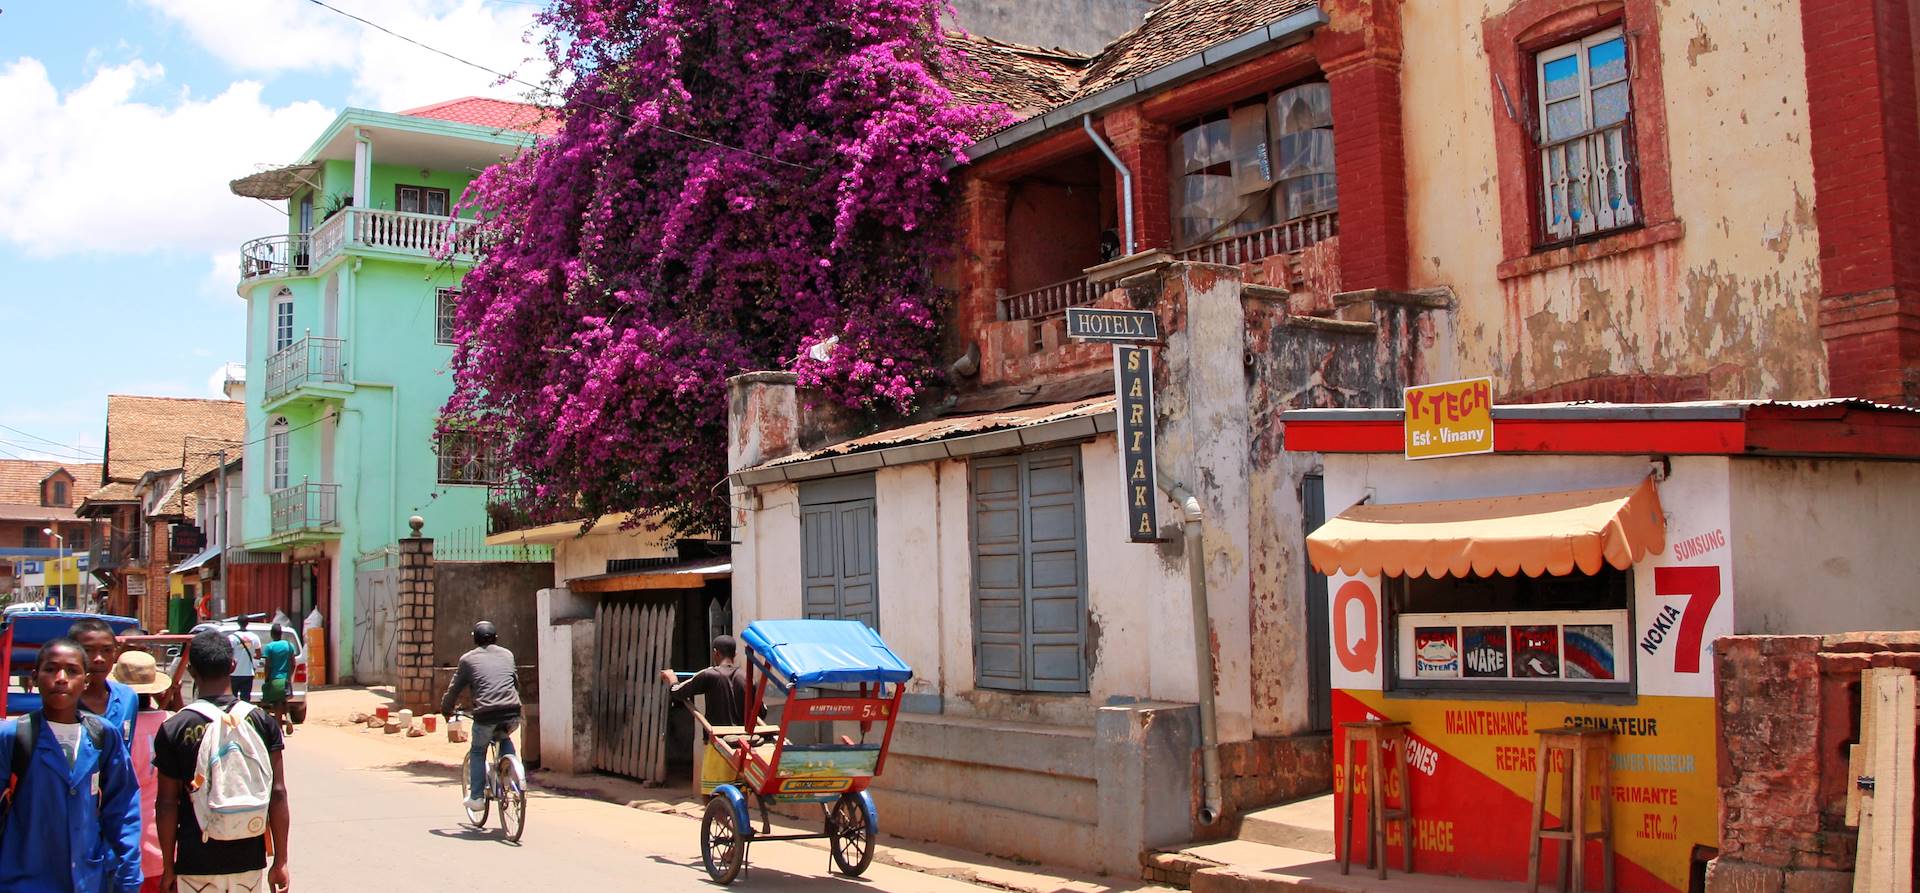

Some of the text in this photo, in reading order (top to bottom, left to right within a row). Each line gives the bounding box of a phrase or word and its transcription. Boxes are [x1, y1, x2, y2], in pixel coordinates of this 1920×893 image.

[1078, 314, 1145, 335] HOTELY
[1407, 382, 1489, 425] Y-TECH
[1127, 350, 1152, 535] SARIAKA
[1412, 430, 1431, 447] Est
[1439, 427, 1485, 443] Vinany
[1673, 528, 1726, 562] SUMSUNG
[1333, 580, 1378, 674] Q
[1640, 604, 1681, 656] NOKIA
[1654, 566, 1720, 673] 7
[1466, 648, 1505, 673] WARE
[1445, 710, 1529, 736] MAINTENANCE
